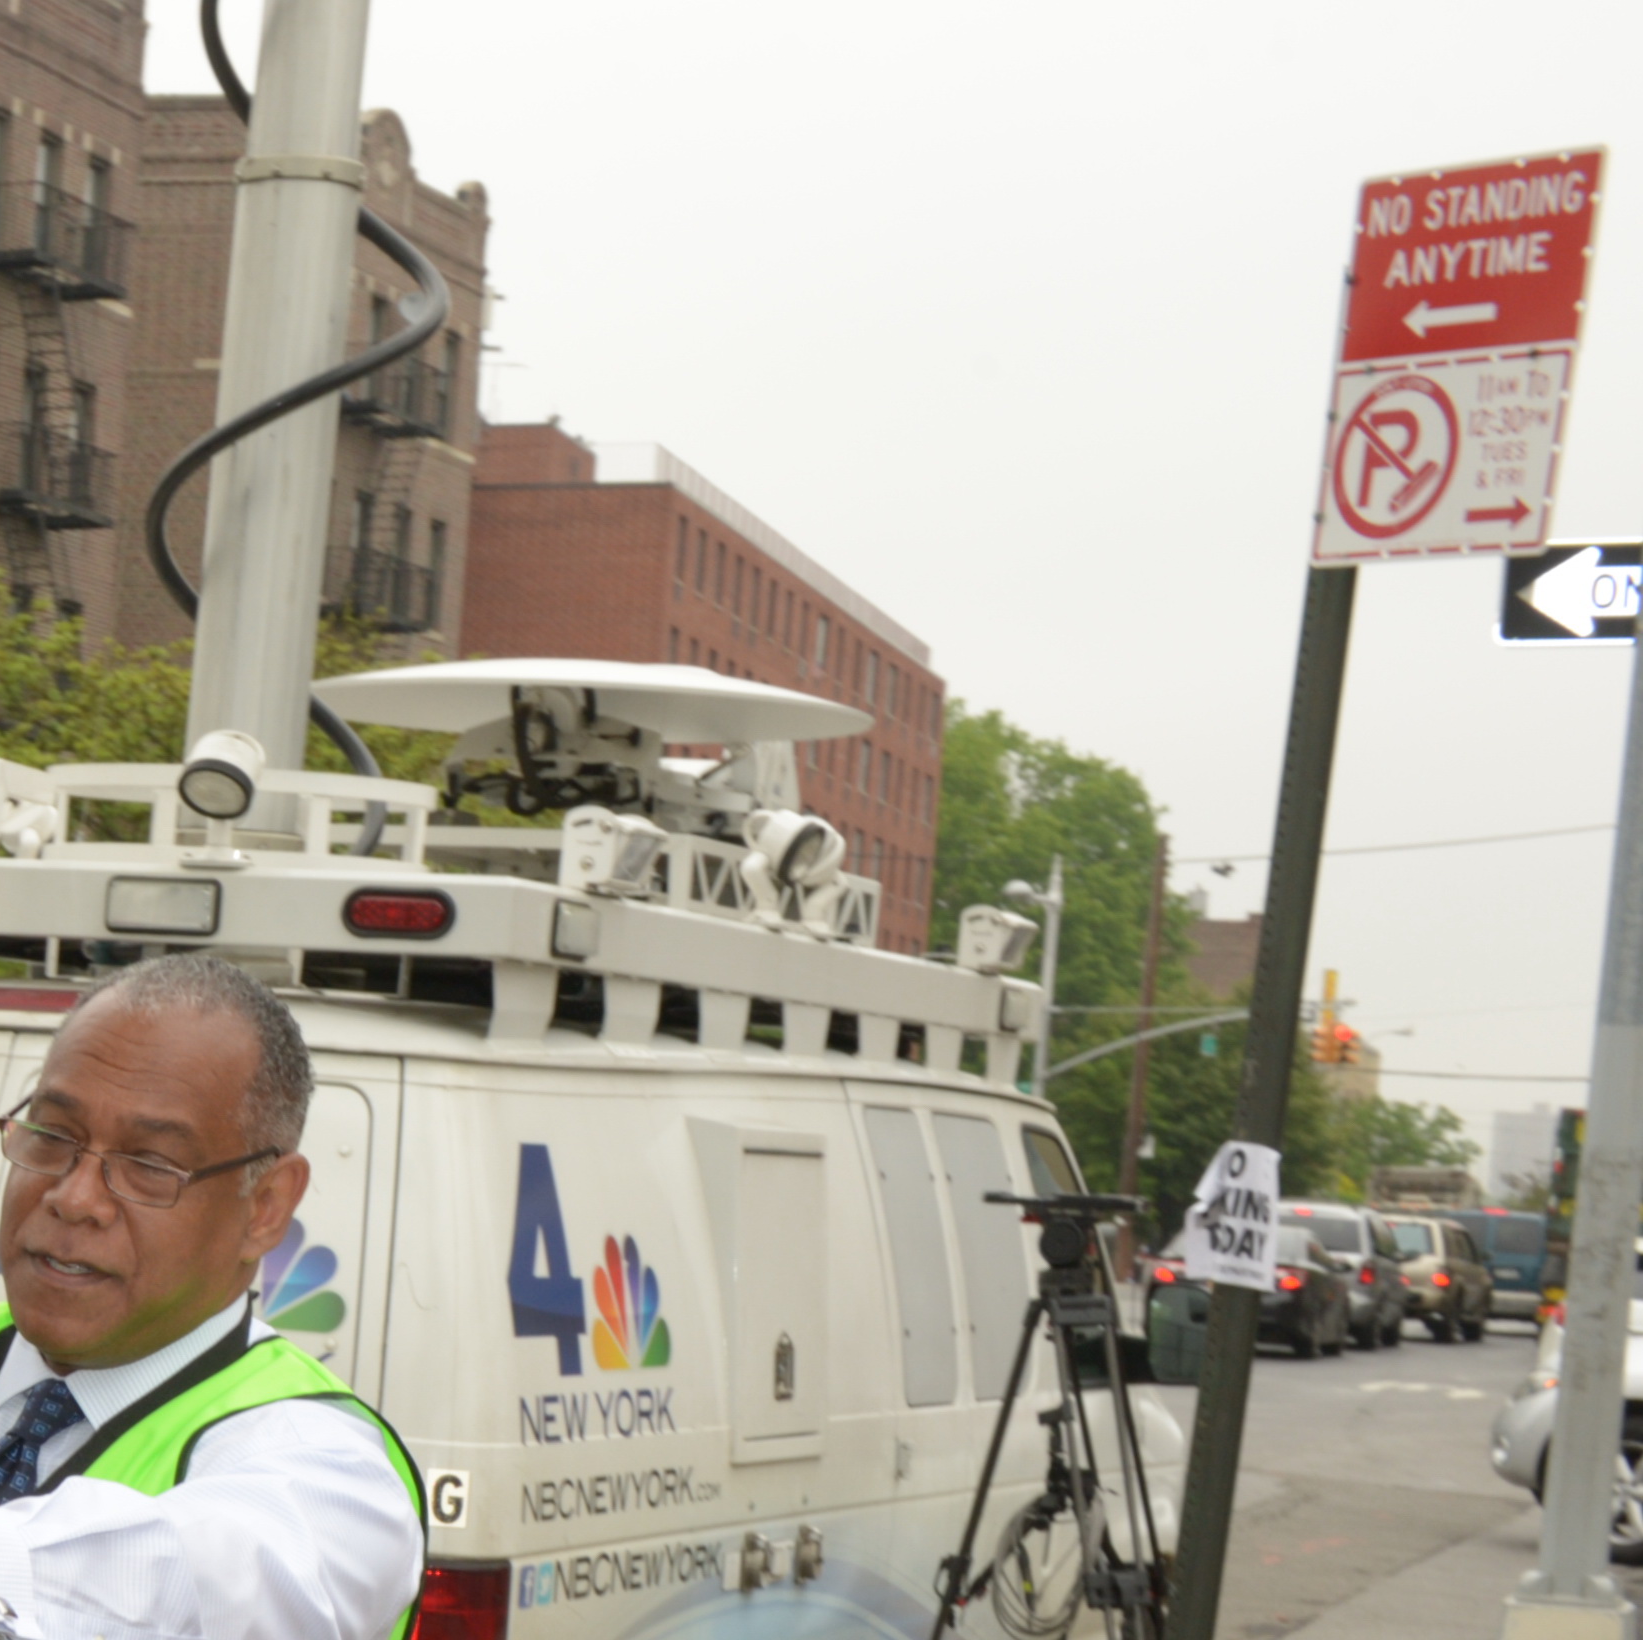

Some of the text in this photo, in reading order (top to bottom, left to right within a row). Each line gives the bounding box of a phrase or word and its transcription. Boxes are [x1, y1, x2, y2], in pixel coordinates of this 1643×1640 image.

[1367, 171, 1588, 238] NO STANDING
[1383, 231, 1553, 289] ANYTIME
[506, 1142, 587, 1376] 4
[518, 1386, 677, 1446] NEW YORK
[431, 1473, 465, 1525] G
